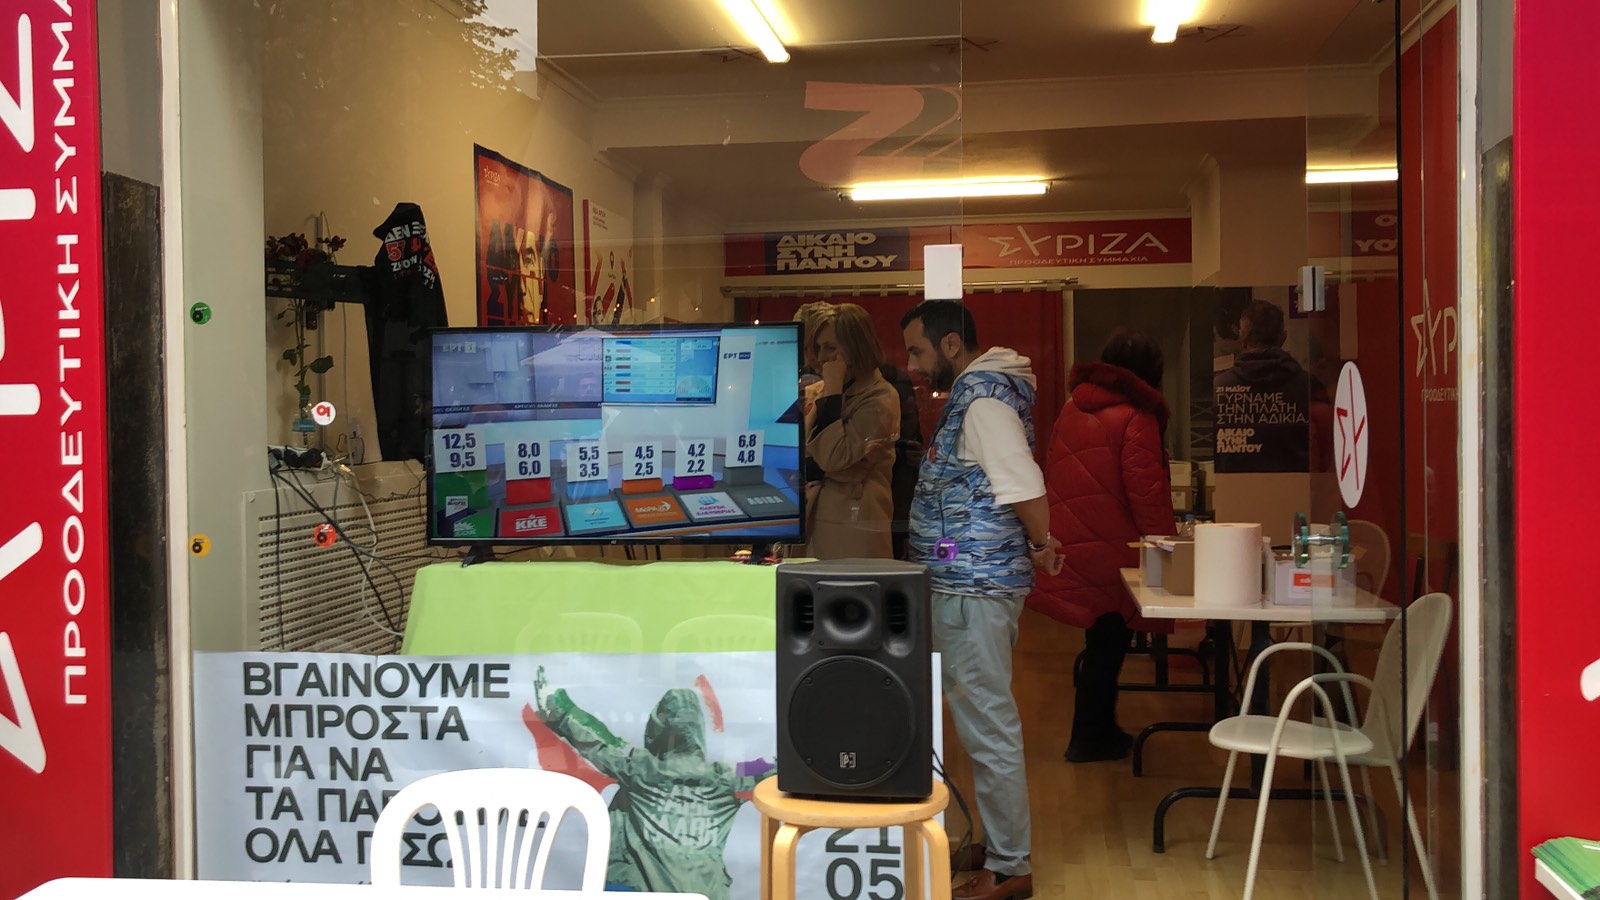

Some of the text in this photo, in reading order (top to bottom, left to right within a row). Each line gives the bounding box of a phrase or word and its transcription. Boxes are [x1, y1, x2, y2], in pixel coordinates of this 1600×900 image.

[776, 232, 877, 247] ΔΙΚΑΙΟ
[988, 225, 1168, 257] ΣΥΡΙΖΑ
[776, 245, 856, 259] ΣΥΝΗ
[776, 255, 898, 271] ΠΑΝΤΟΥ
[1216, 392, 1285, 404] ΓΥΡΝΑΜΕ
[1217, 402, 1297, 414] ΤΗΝ ΠΛΑΤΗ
[1216, 413, 1255, 425] ΣΤΗΝ
[442, 432, 476, 450] 12,5
[738, 434, 757, 448] 6,8
[1216, 444, 1263, 454] ΠΑΝΤΟΥ
[518, 442, 541, 459] 8,0
[578, 446, 600, 461] 5,5
[635, 445, 654, 460] 4,5
[687, 443, 706, 458] 4,2
[737, 450, 756, 464] 4,8
[450, 451, 476, 469] 9,5
[518, 460, 542, 476] 6,0
[687, 459, 706, 473] 2,2
[57, 234, 87, 704] ΠΡΟΟΔΕΥΤΙΚΗ
[579, 462, 600, 478] 3,5
[635, 462, 654, 476] 2,5
[243, 662, 510, 699] ΒΓΑΙΝΟΥΜΕ
[245, 703, 469, 741] ΜΠΡΟΣΤΑ
[246, 745, 394, 782] ΓΙΑ ΝΑ
[245, 786, 303, 821] ΤΑ
[245, 827, 343, 864] ΟΛΑ
[826, 857, 904, 900] 05
